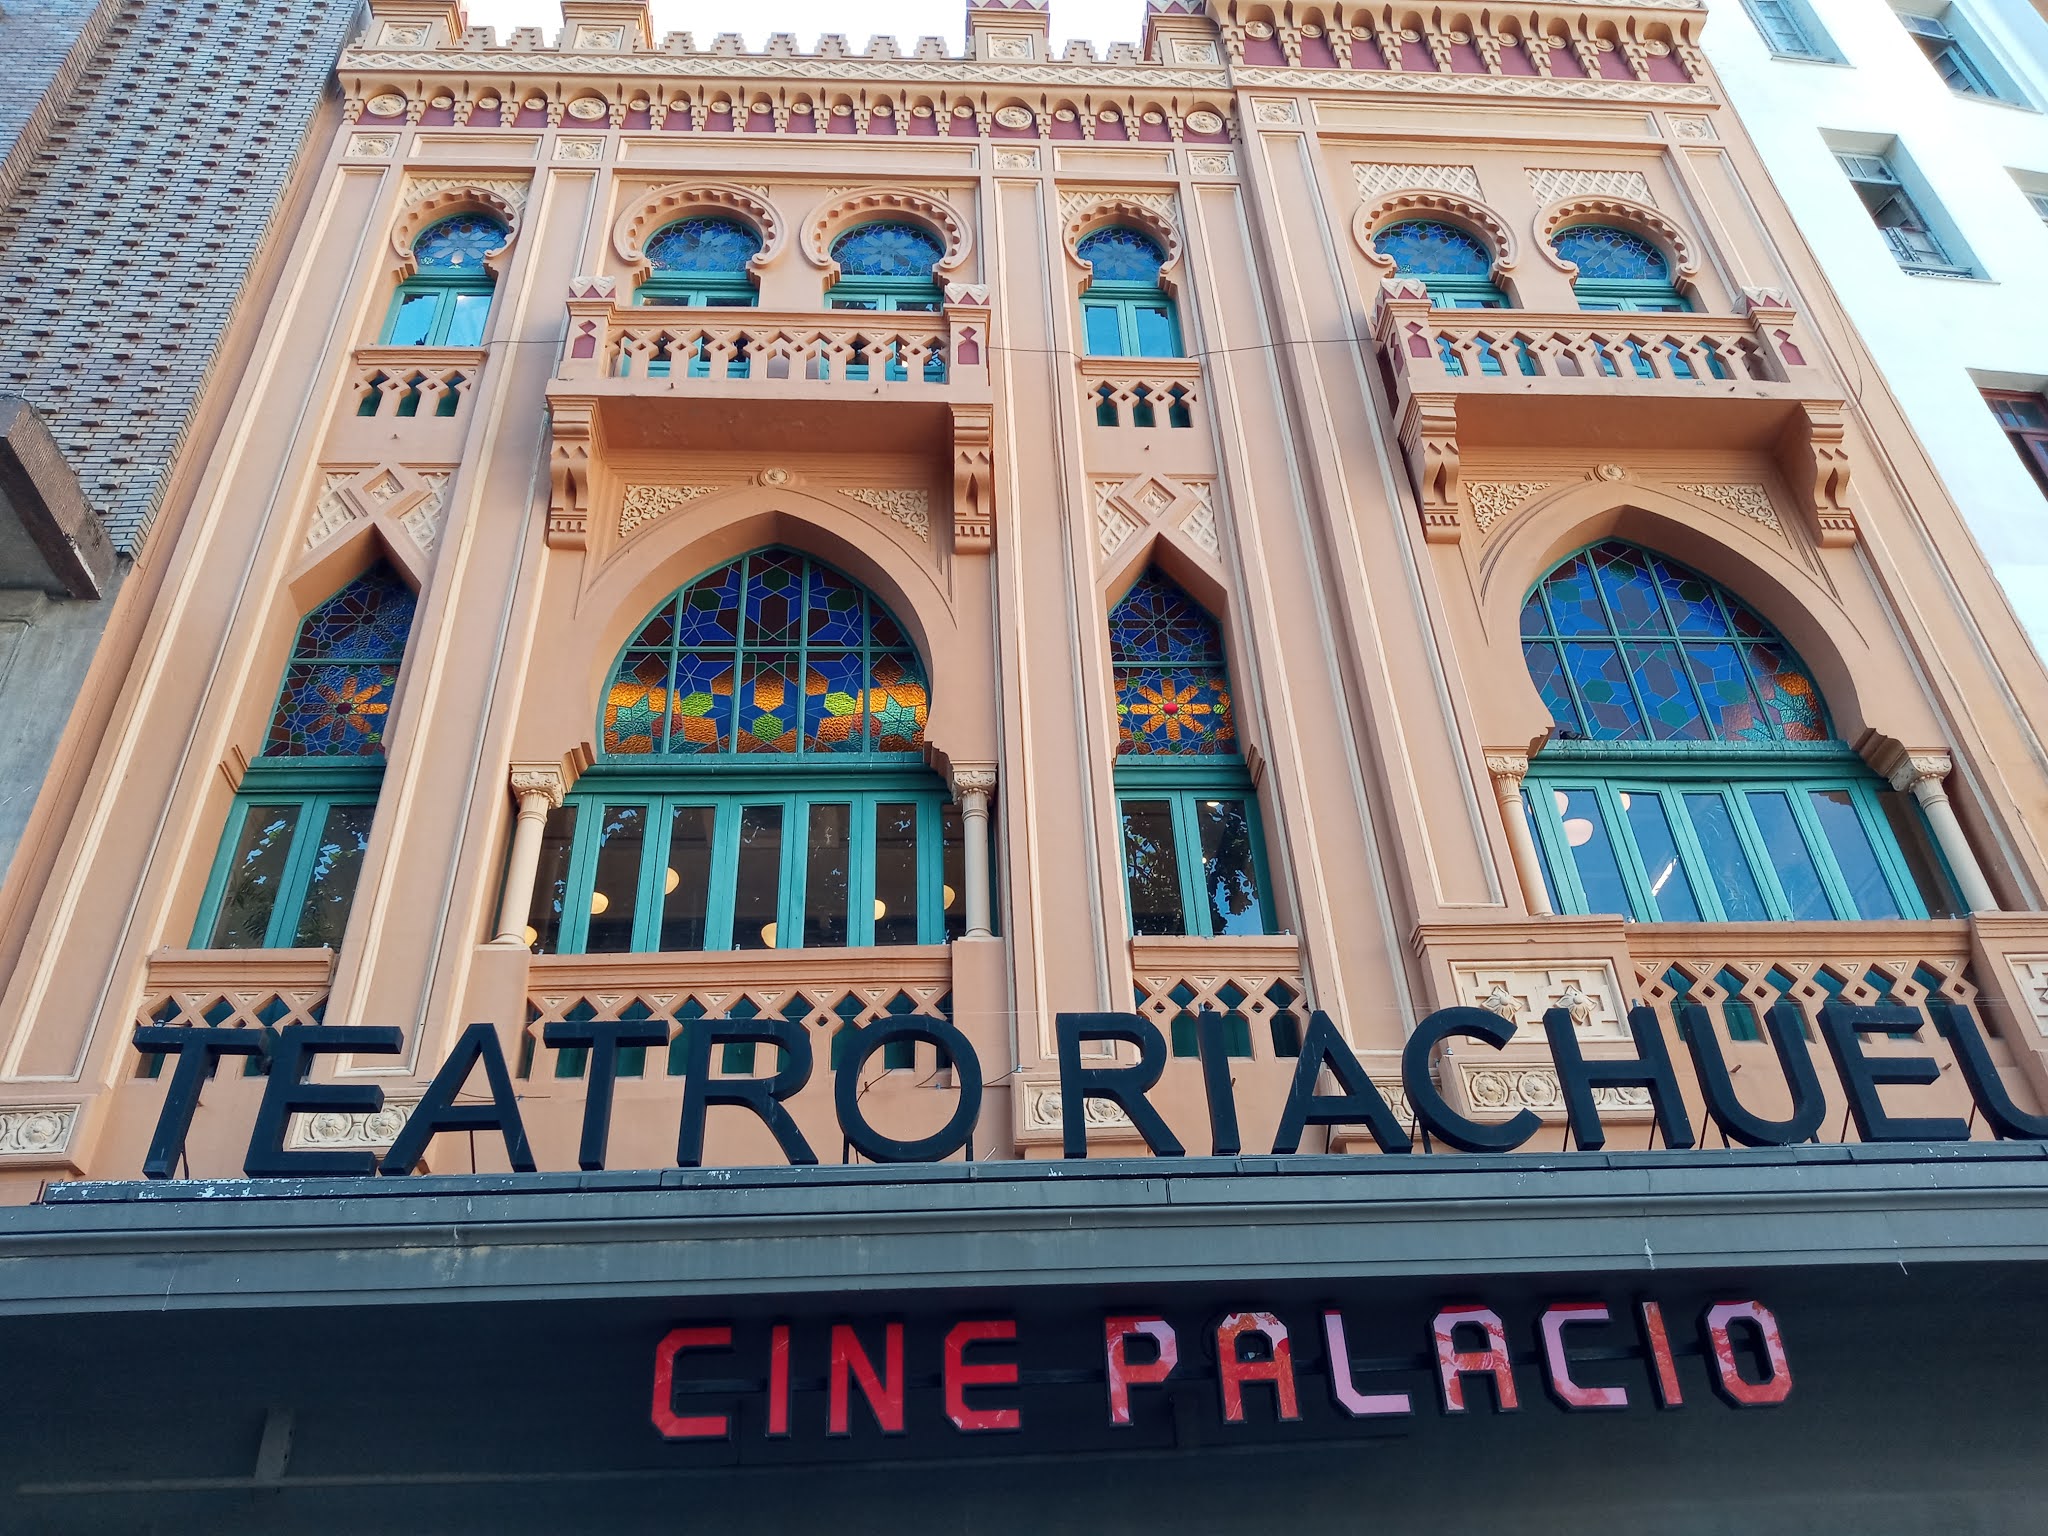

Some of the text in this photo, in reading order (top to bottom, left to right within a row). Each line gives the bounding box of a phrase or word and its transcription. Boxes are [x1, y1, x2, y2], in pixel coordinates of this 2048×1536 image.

[133, 1014, 983, 1180] TEATRO
[650, 1299, 1793, 1440] CINE PALACIO
